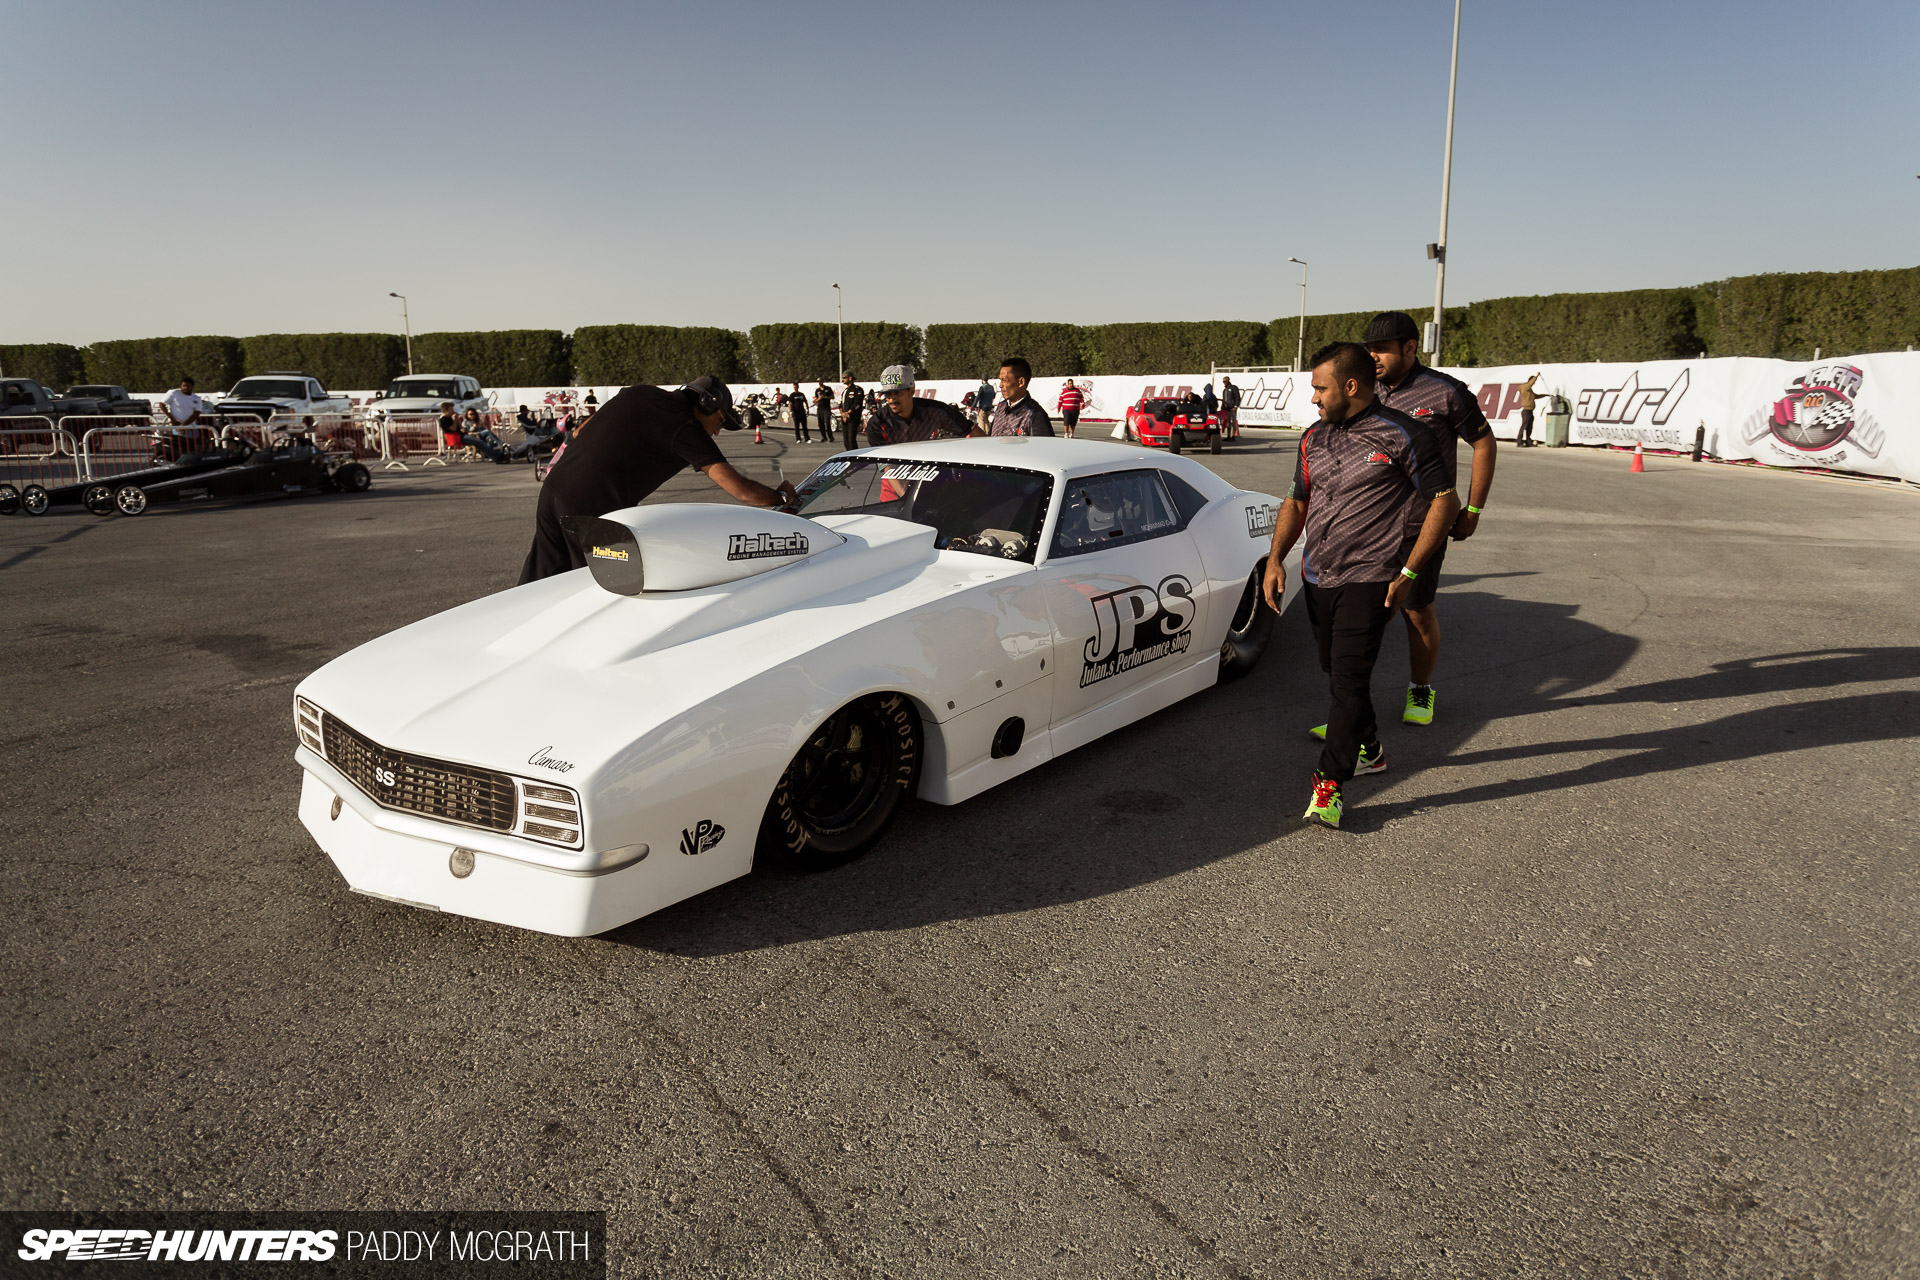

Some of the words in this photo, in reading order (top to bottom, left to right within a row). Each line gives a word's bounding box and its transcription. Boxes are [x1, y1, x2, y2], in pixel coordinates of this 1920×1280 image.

[1239, 377, 1294, 410] drl
[1468, 383, 1521, 420] AP
[1576, 367, 1690, 426] adrl
[817, 461, 851, 477] 209
[1370, 453, 1389, 463] JPS
[1246, 503, 1282, 530] Halte
[592, 546, 629, 559] Haltech
[728, 532, 809, 554] Haltech
[752, 550, 786, 558] MANAGEMENT
[1084, 574, 1195, 663] JPS
[1116, 640, 1170, 673] Performance
[1170, 631, 1191, 653] shop
[528, 746, 576, 773] Camaro
[375, 766, 396, 787] SS
[681, 819, 713, 855] VP
